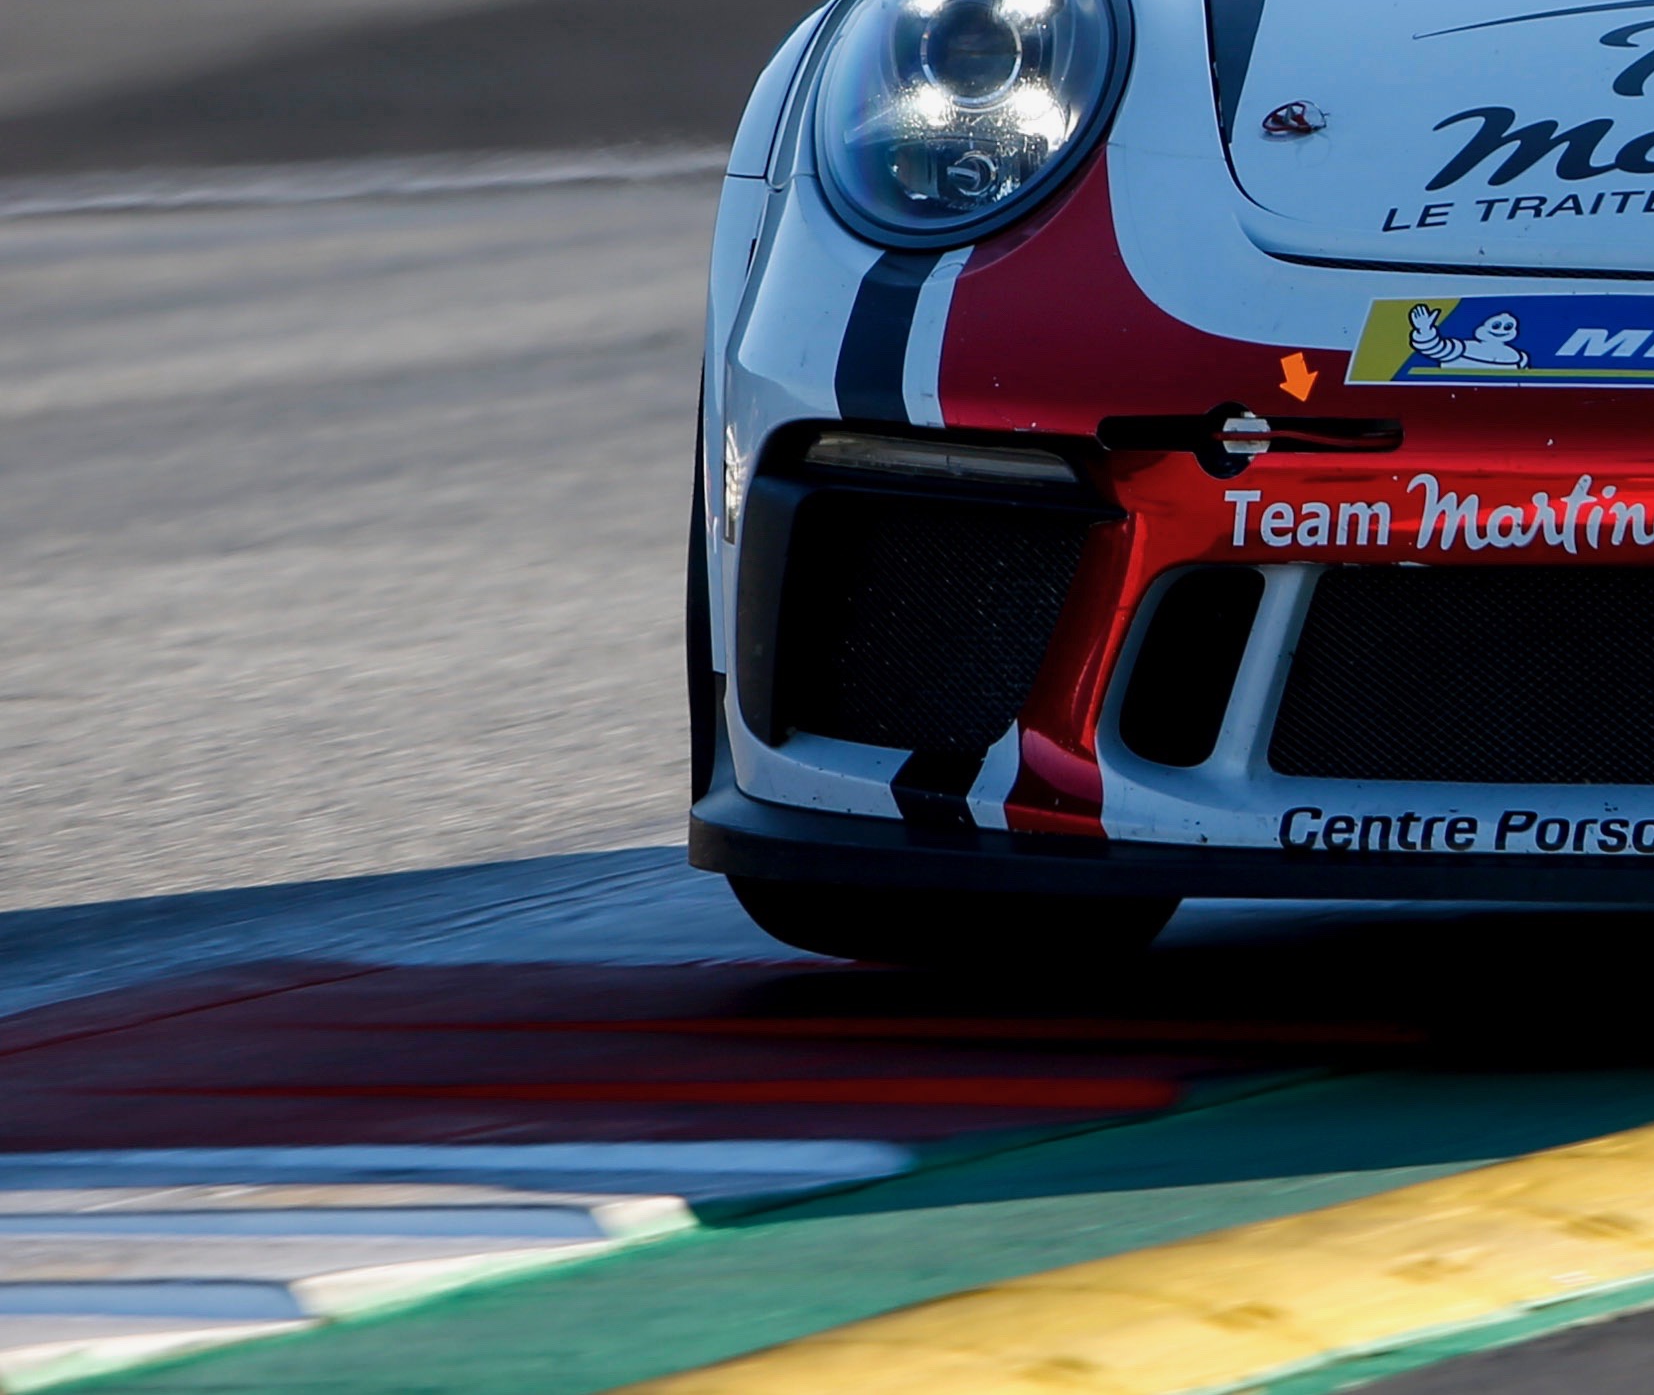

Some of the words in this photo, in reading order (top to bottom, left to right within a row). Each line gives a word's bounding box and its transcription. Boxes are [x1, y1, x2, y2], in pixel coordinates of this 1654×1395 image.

[1382, 200, 1448, 231] LE
[1224, 490, 1392, 550] Team
[1280, 806, 1478, 856] Centre
